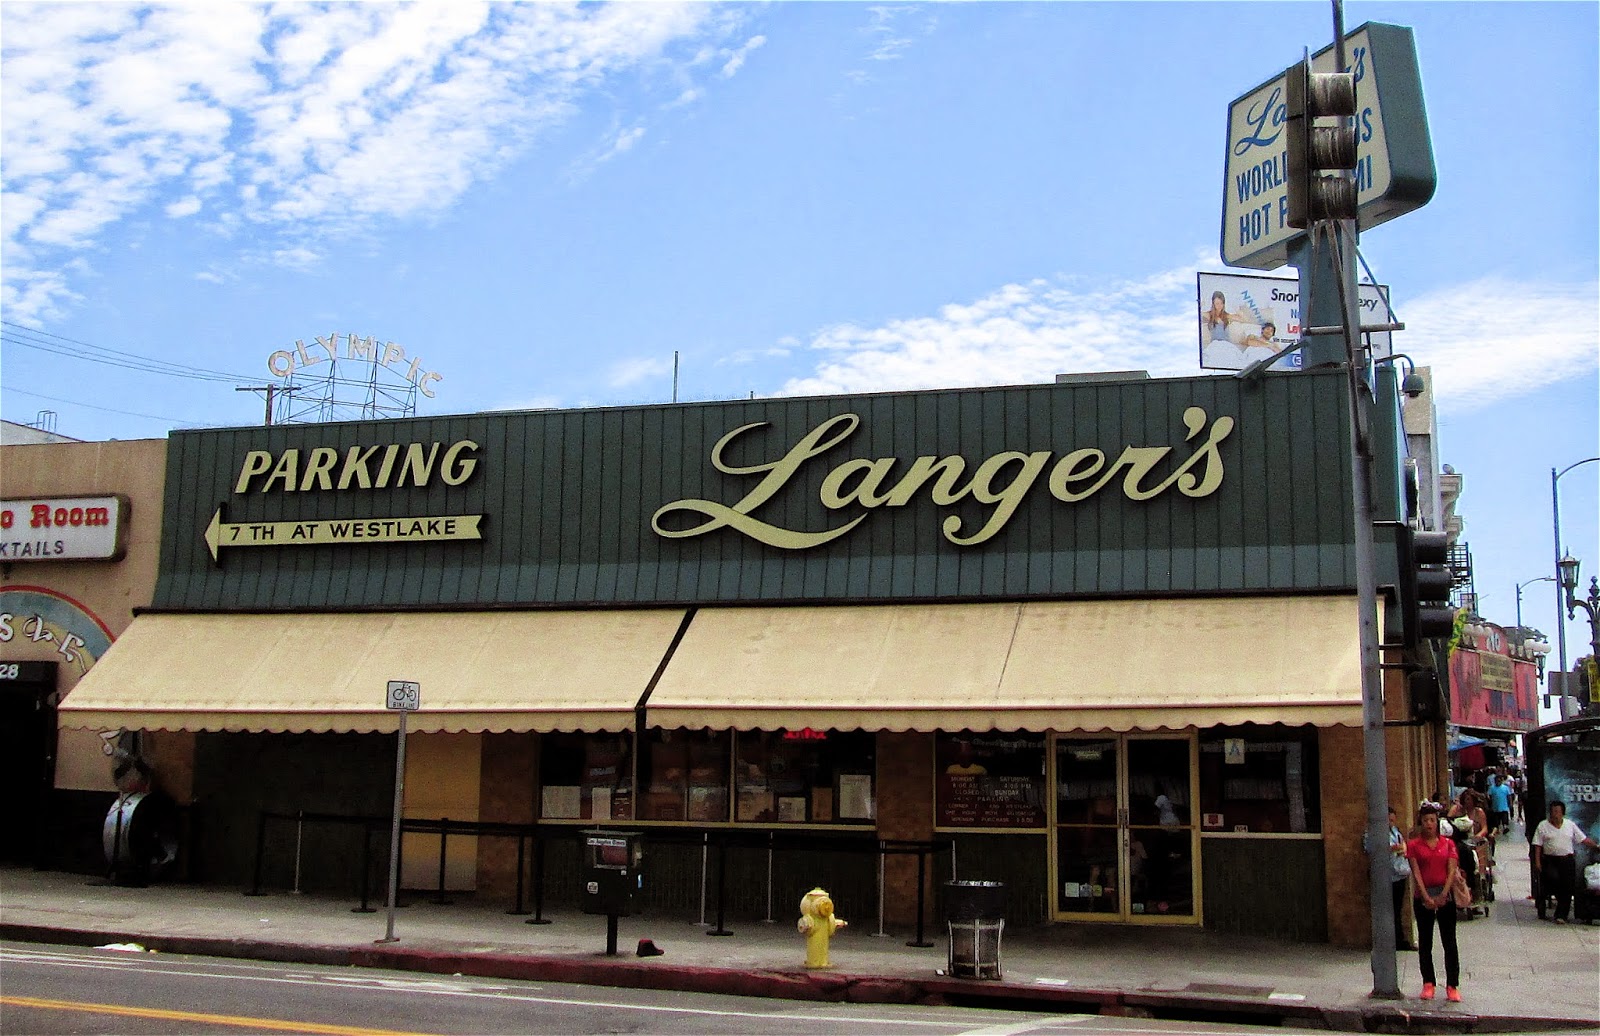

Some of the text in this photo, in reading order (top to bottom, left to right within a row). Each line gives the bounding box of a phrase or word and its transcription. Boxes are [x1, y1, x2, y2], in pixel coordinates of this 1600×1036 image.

[1239, 203, 1272, 247] HOT
[268, 333, 442, 399] OLYMPIC
[235, 439, 479, 494] PARKING
[651, 406, 1235, 550] Langer's
[30, 504, 109, 529] Room
[231, 519, 456, 541] 7 TH AT WESTLAKE
